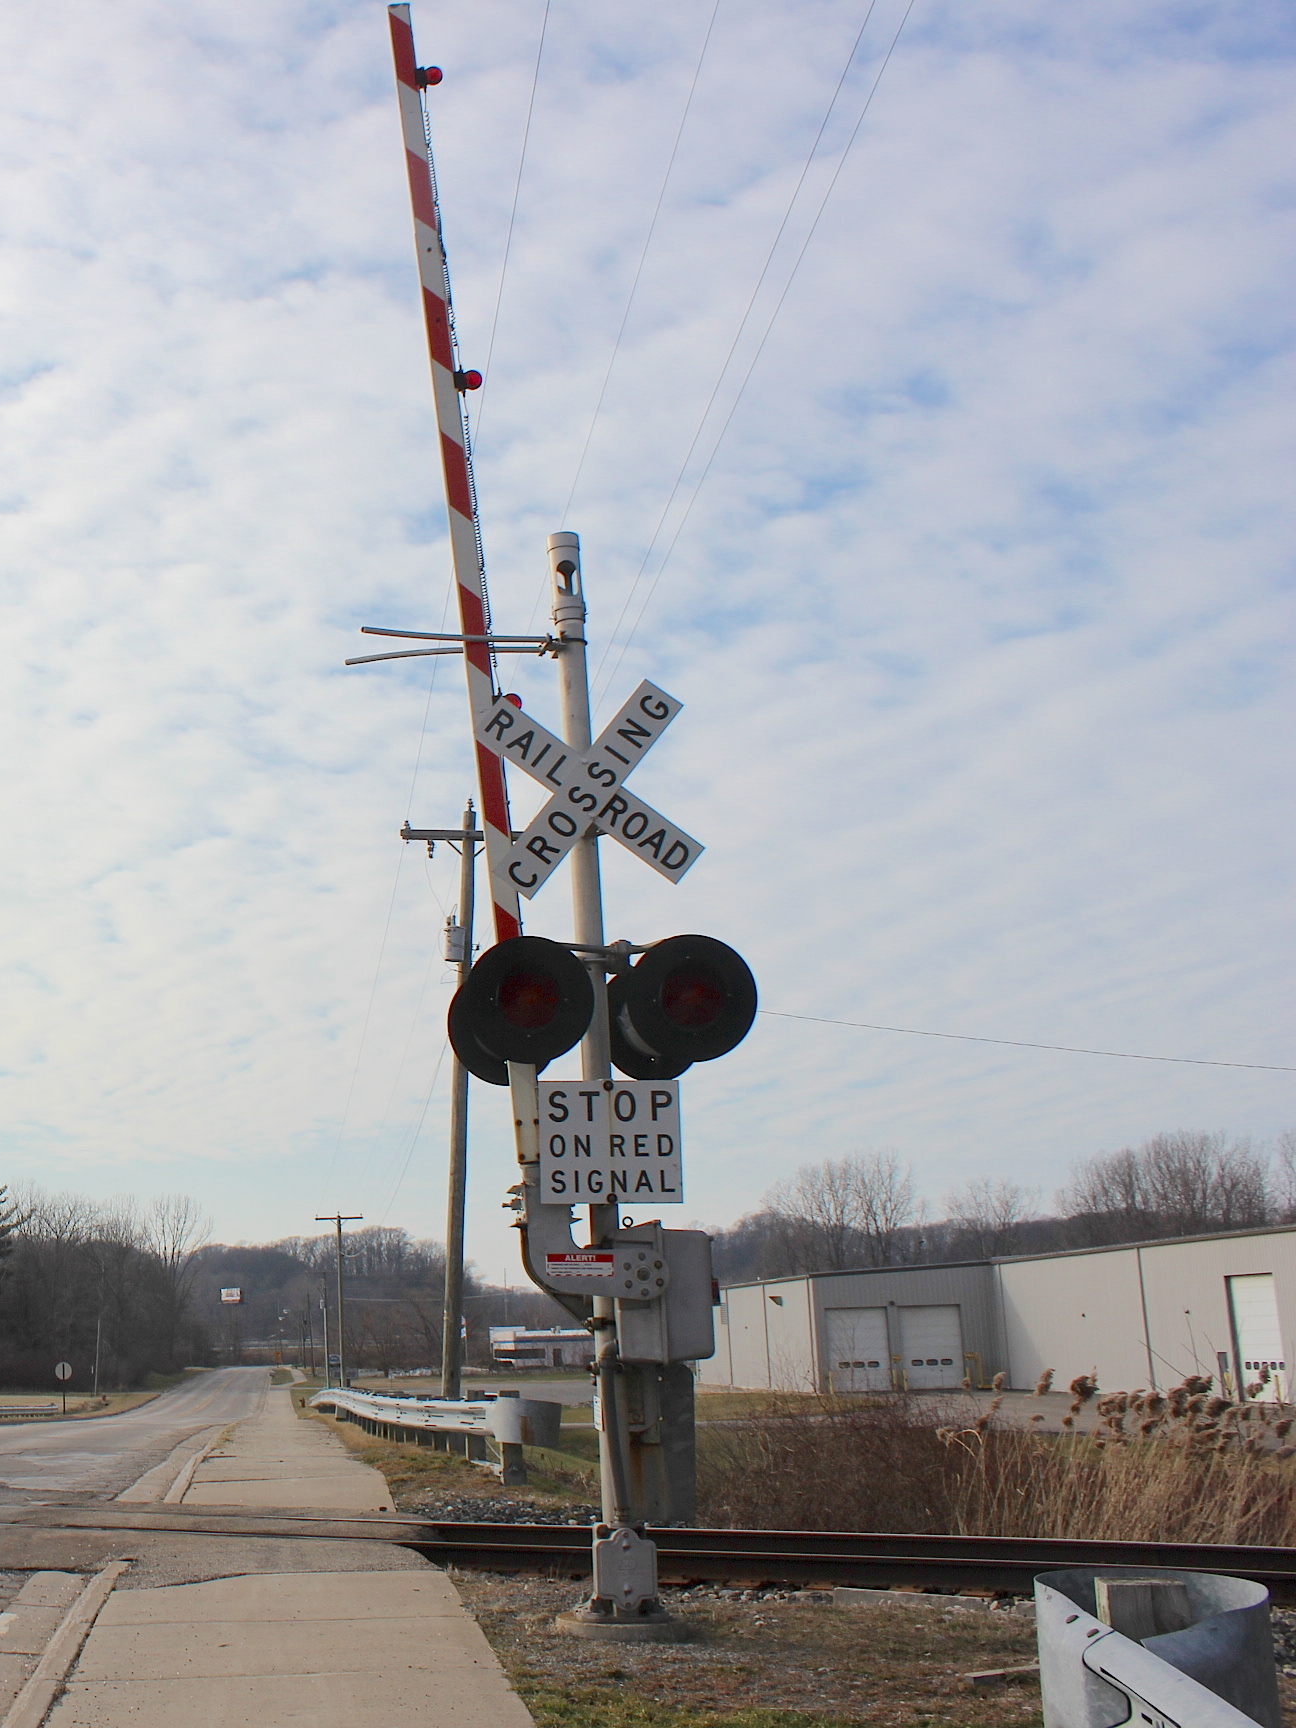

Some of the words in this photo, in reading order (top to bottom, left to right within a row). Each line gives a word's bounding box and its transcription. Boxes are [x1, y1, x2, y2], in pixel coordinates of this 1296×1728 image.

[484, 708, 567, 787] RAIL
[598, 794, 690, 870] ROAD
[508, 694, 670, 888] CROSSING
[548, 1090, 673, 1122] STOP
[549, 1134, 592, 1158] ON
[609, 1133, 675, 1158] RED
[551, 1169, 677, 1194] SIGNAL
[565, 1254, 597, 1262] ALERT!
